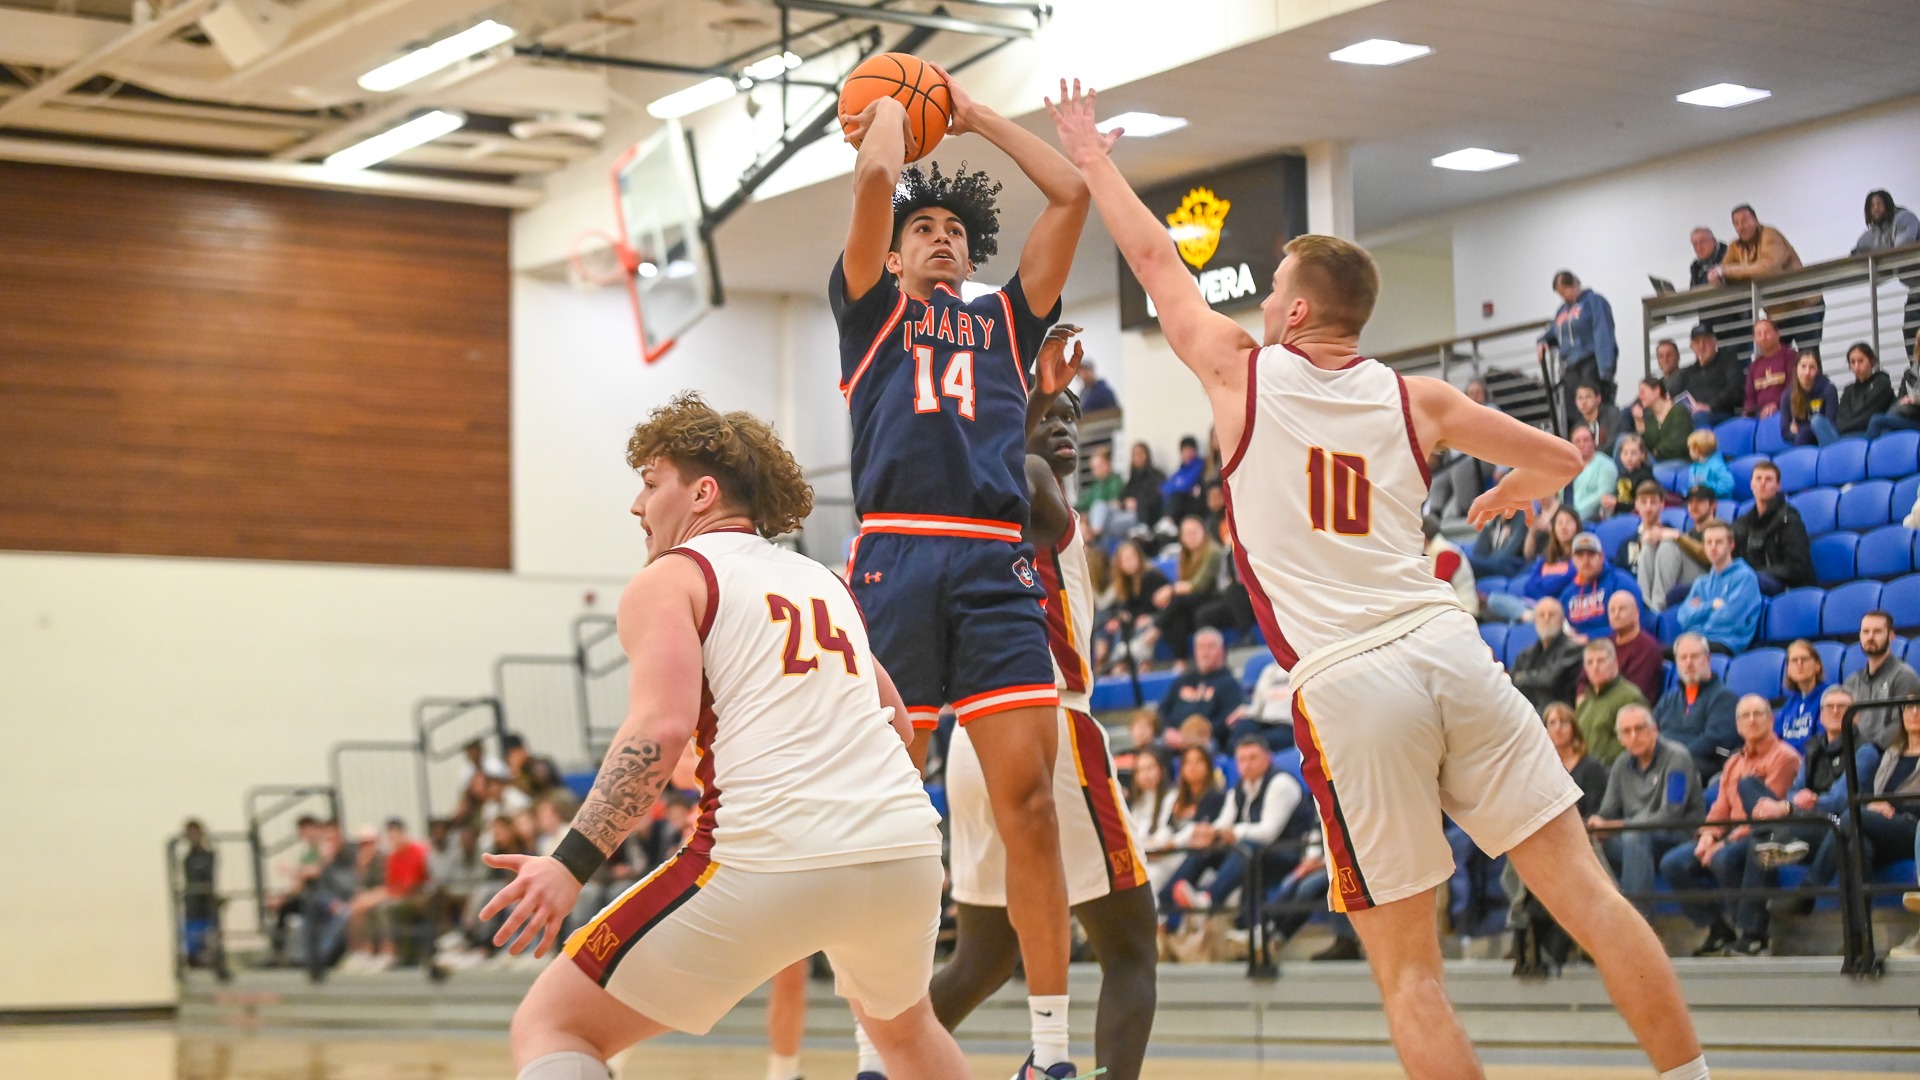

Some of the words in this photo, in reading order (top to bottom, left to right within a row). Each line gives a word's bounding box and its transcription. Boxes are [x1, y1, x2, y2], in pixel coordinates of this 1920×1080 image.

[913, 344, 976, 421] 14
[1306, 444, 1374, 537] 10
[765, 592, 861, 678] 24
[1110, 847, 1132, 875] N
[586, 922, 620, 961] N
